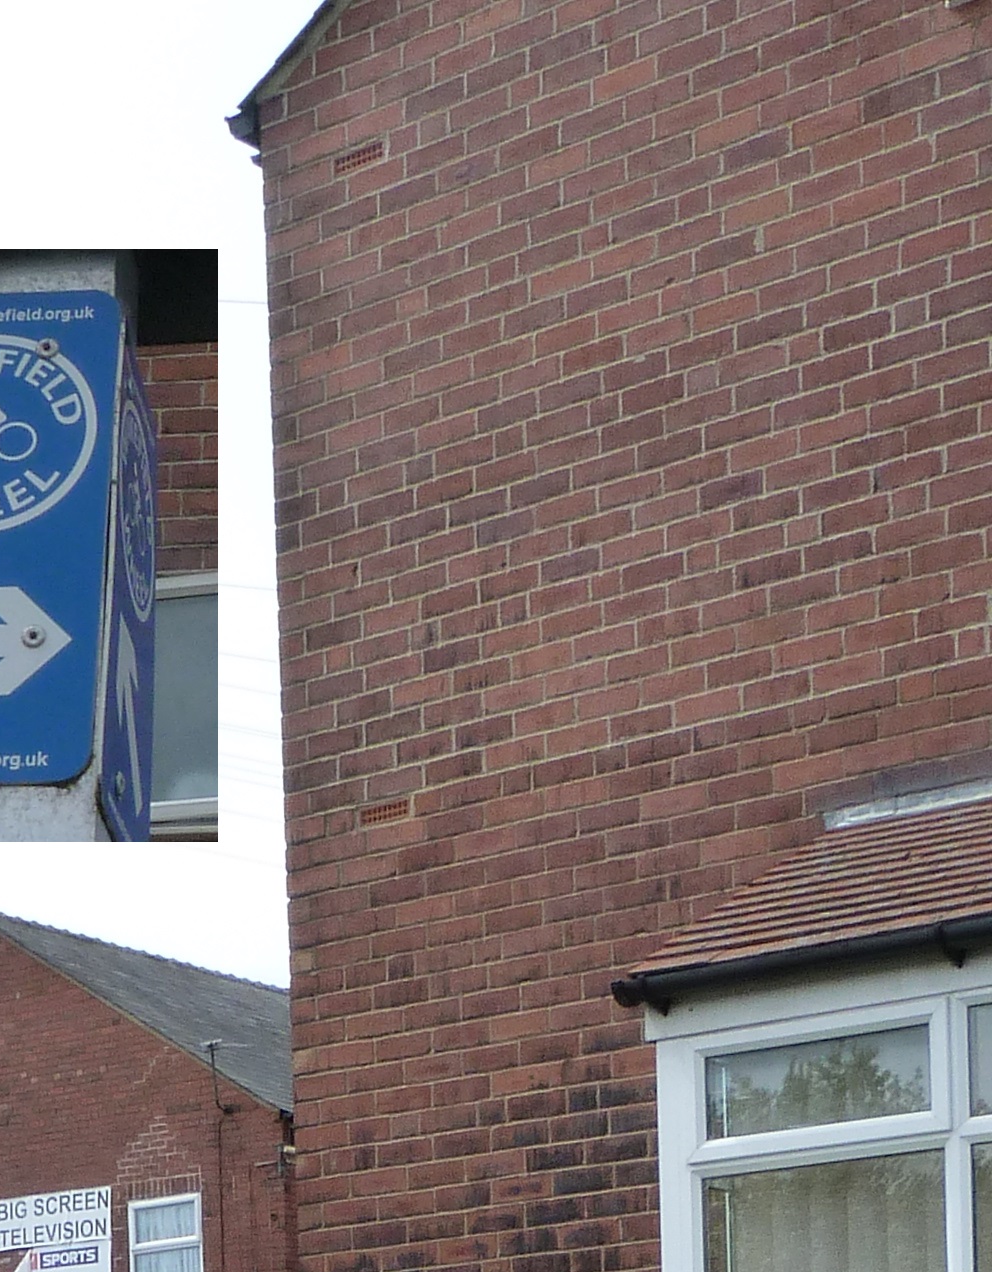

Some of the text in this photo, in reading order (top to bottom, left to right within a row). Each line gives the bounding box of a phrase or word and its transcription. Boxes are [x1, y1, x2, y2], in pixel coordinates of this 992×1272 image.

[33, 1190, 109, 1216] SCREEN
[0, 1218, 107, 1247] TELEVISION
[42, 1249, 96, 1267] SPORTS
